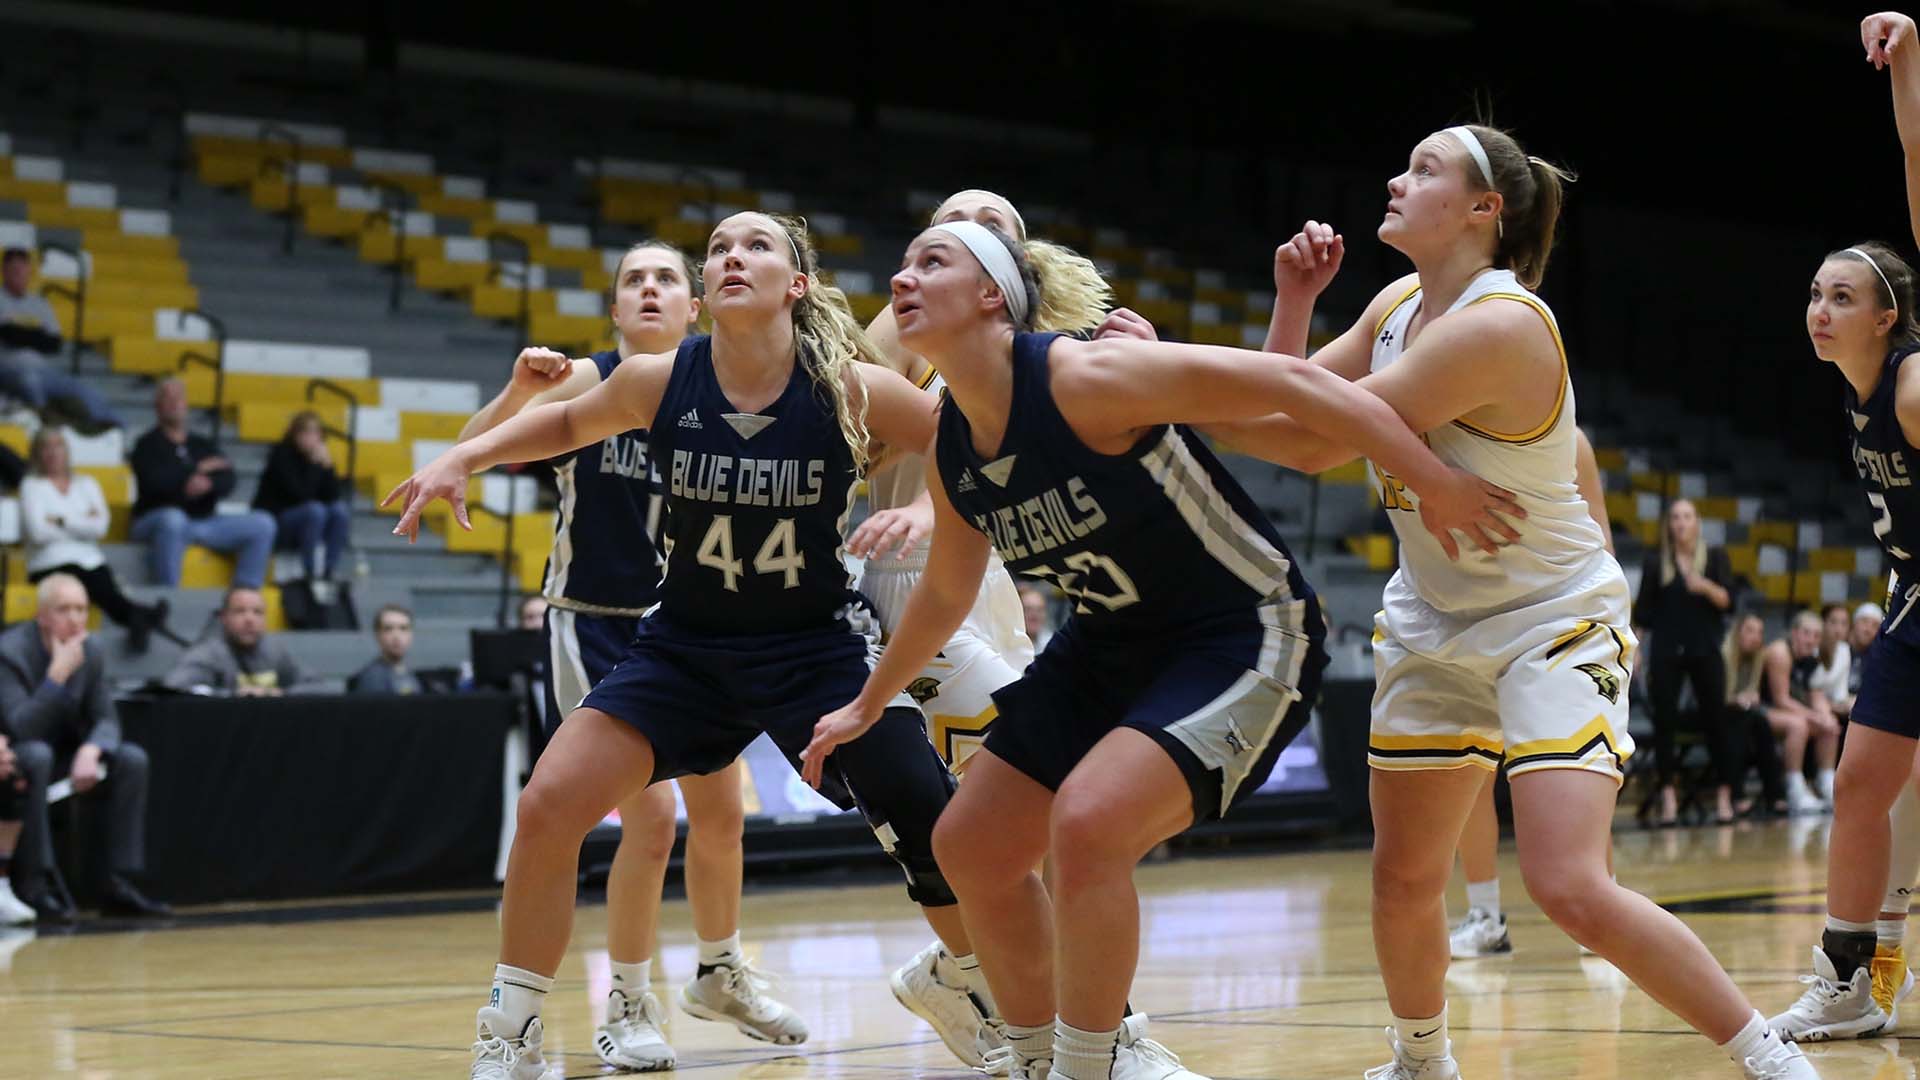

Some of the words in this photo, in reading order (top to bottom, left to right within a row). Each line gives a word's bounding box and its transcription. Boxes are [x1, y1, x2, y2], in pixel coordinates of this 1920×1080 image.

[600, 436, 648, 480] BLUE
[671, 449, 733, 503] BLUE
[735, 458, 825, 507] DEVILS
[1017, 476, 1108, 555] DEVILS
[697, 514, 806, 592] 44
